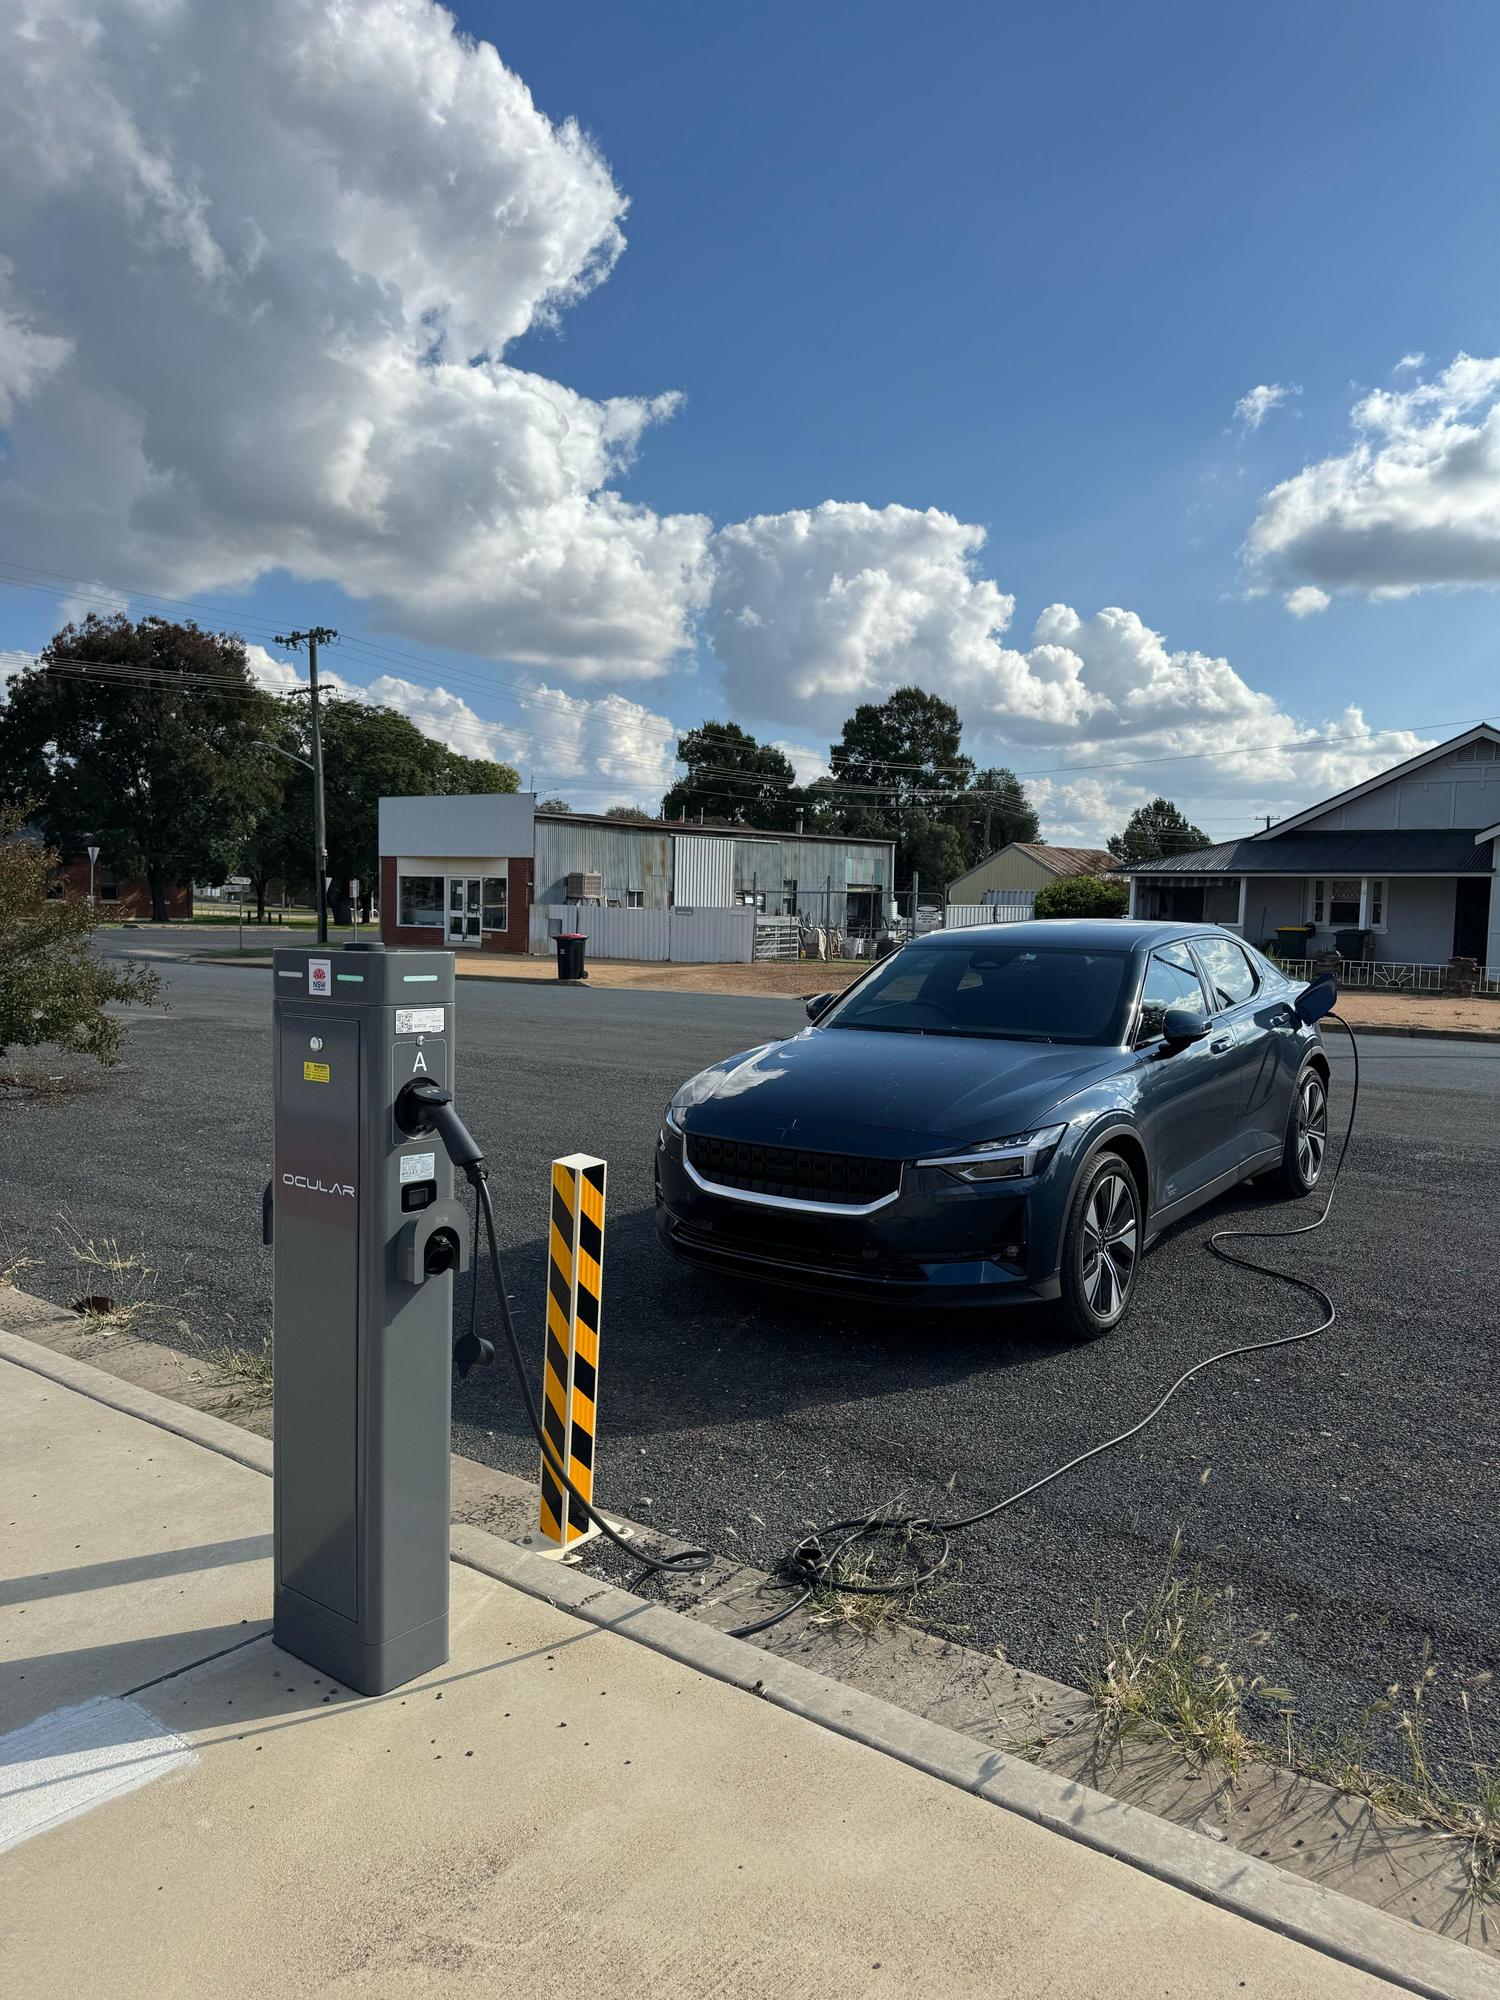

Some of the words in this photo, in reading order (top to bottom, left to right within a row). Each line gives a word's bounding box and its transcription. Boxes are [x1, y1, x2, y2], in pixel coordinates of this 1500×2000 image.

[312, 980, 326, 988] NSW
[412, 1051, 427, 1073] A
[282, 1173, 355, 1198] OCULAR
